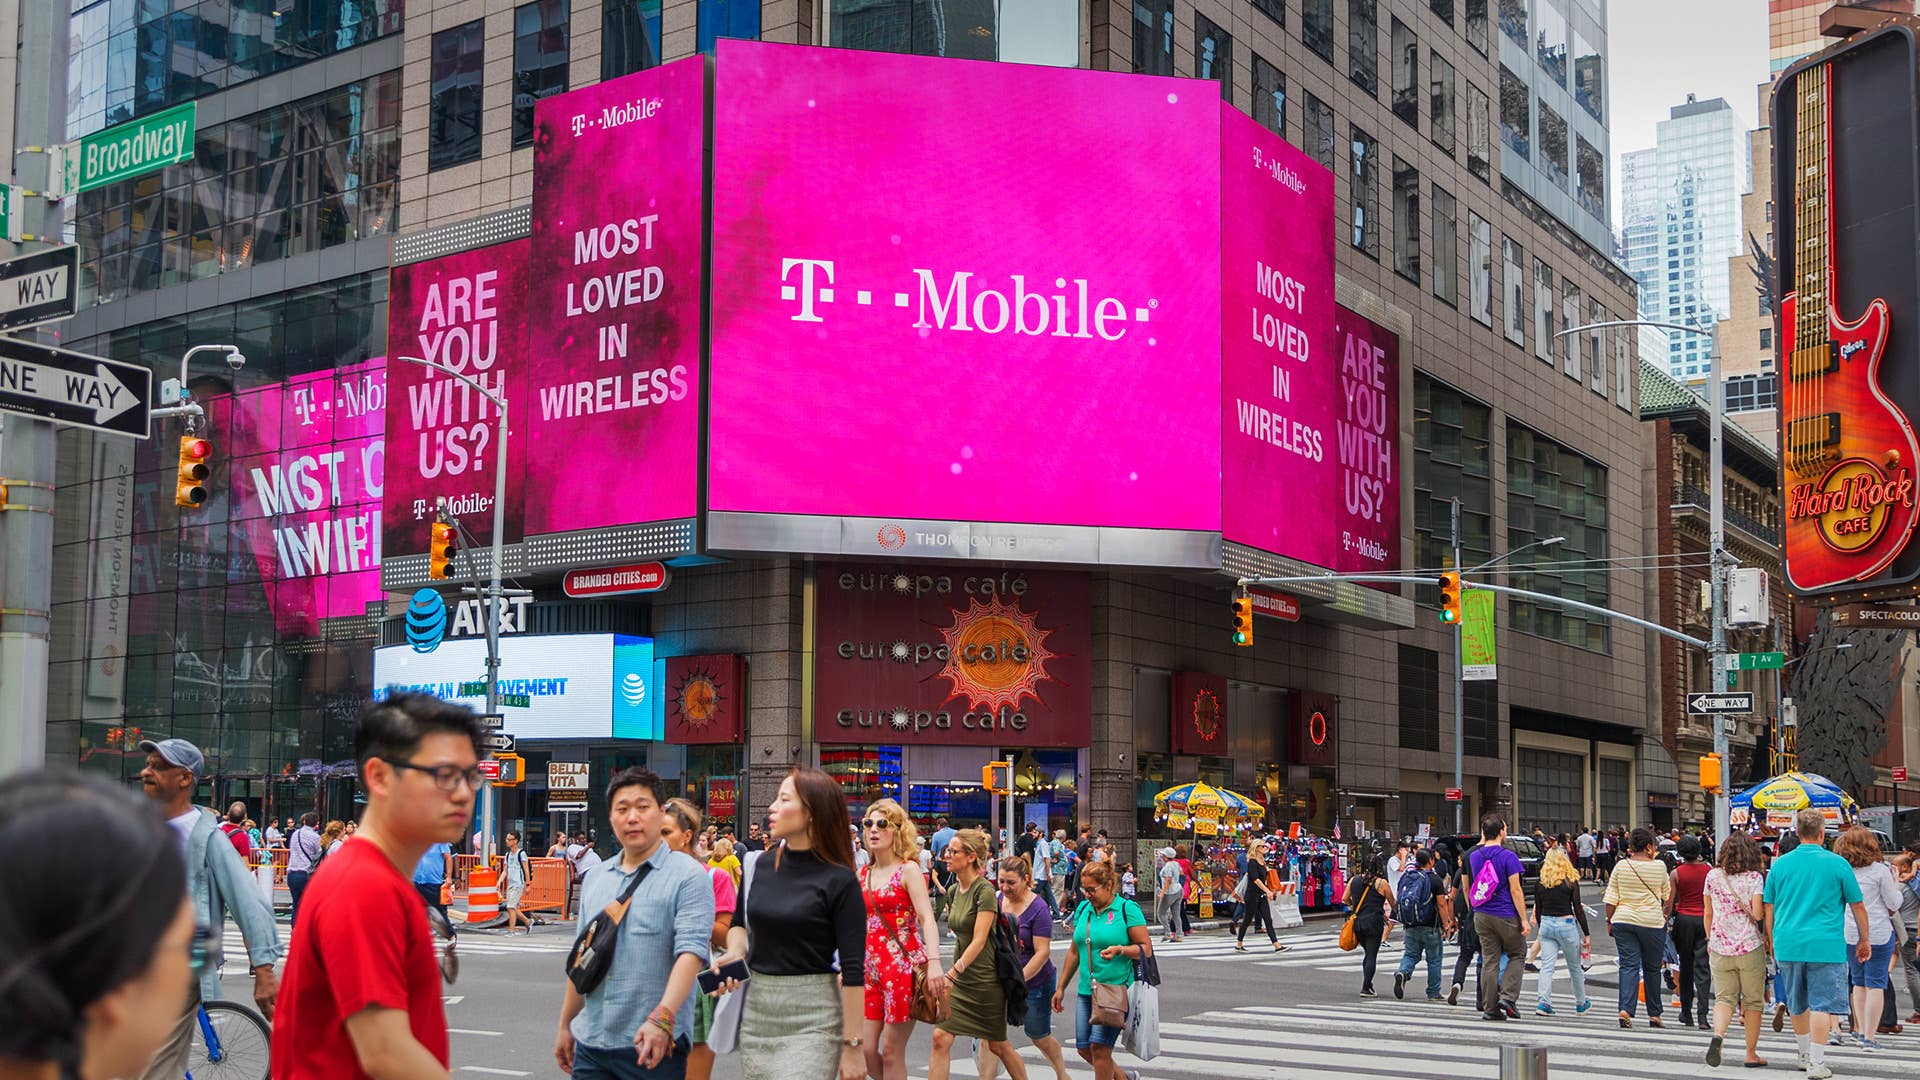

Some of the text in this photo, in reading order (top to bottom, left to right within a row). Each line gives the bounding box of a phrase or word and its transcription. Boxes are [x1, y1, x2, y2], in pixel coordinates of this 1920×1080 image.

[86, 120, 187, 180] Broadway
[574, 214, 659, 265] MOST
[18, 271, 59, 305] WAY
[419, 270, 498, 332] ARE
[566, 266, 664, 317] LOVED
[1256, 261, 1305, 314] MOST
[418, 320, 498, 379] YOU
[598, 323, 628, 361] IN
[1252, 307, 1309, 362] LOVED
[0, 361, 122, 409] NE WAY
[1272, 365, 1290, 402] IN
[1342, 333, 1385, 392] ARE
[408, 369, 506, 430] WITH
[539, 365, 688, 421] WIRELESS
[1341, 375, 1386, 434] YOU
[418, 423, 490, 479] US?
[1236, 398, 1323, 462] WIRELESS
[1336, 419, 1391, 484] WITH
[1345, 469, 1384, 523] US?
[1790, 469, 1913, 519] Hard Rock
[1833, 517, 1870, 534] CAFE
[573, 570, 657, 589] BRANDED CITIES.com
[451, 596, 534, 636] AT&T
[1860, 610, 1920, 620] SPECTACOLO
[1751, 655, 1772, 667] 7 Av
[496, 678, 568, 696] OVEMENT
[1697, 700, 1715, 708] ONE
[1771, 716, 1797, 752] HRRY
[550, 763, 588, 775] BELLA
[550, 776, 577, 787] VITA
